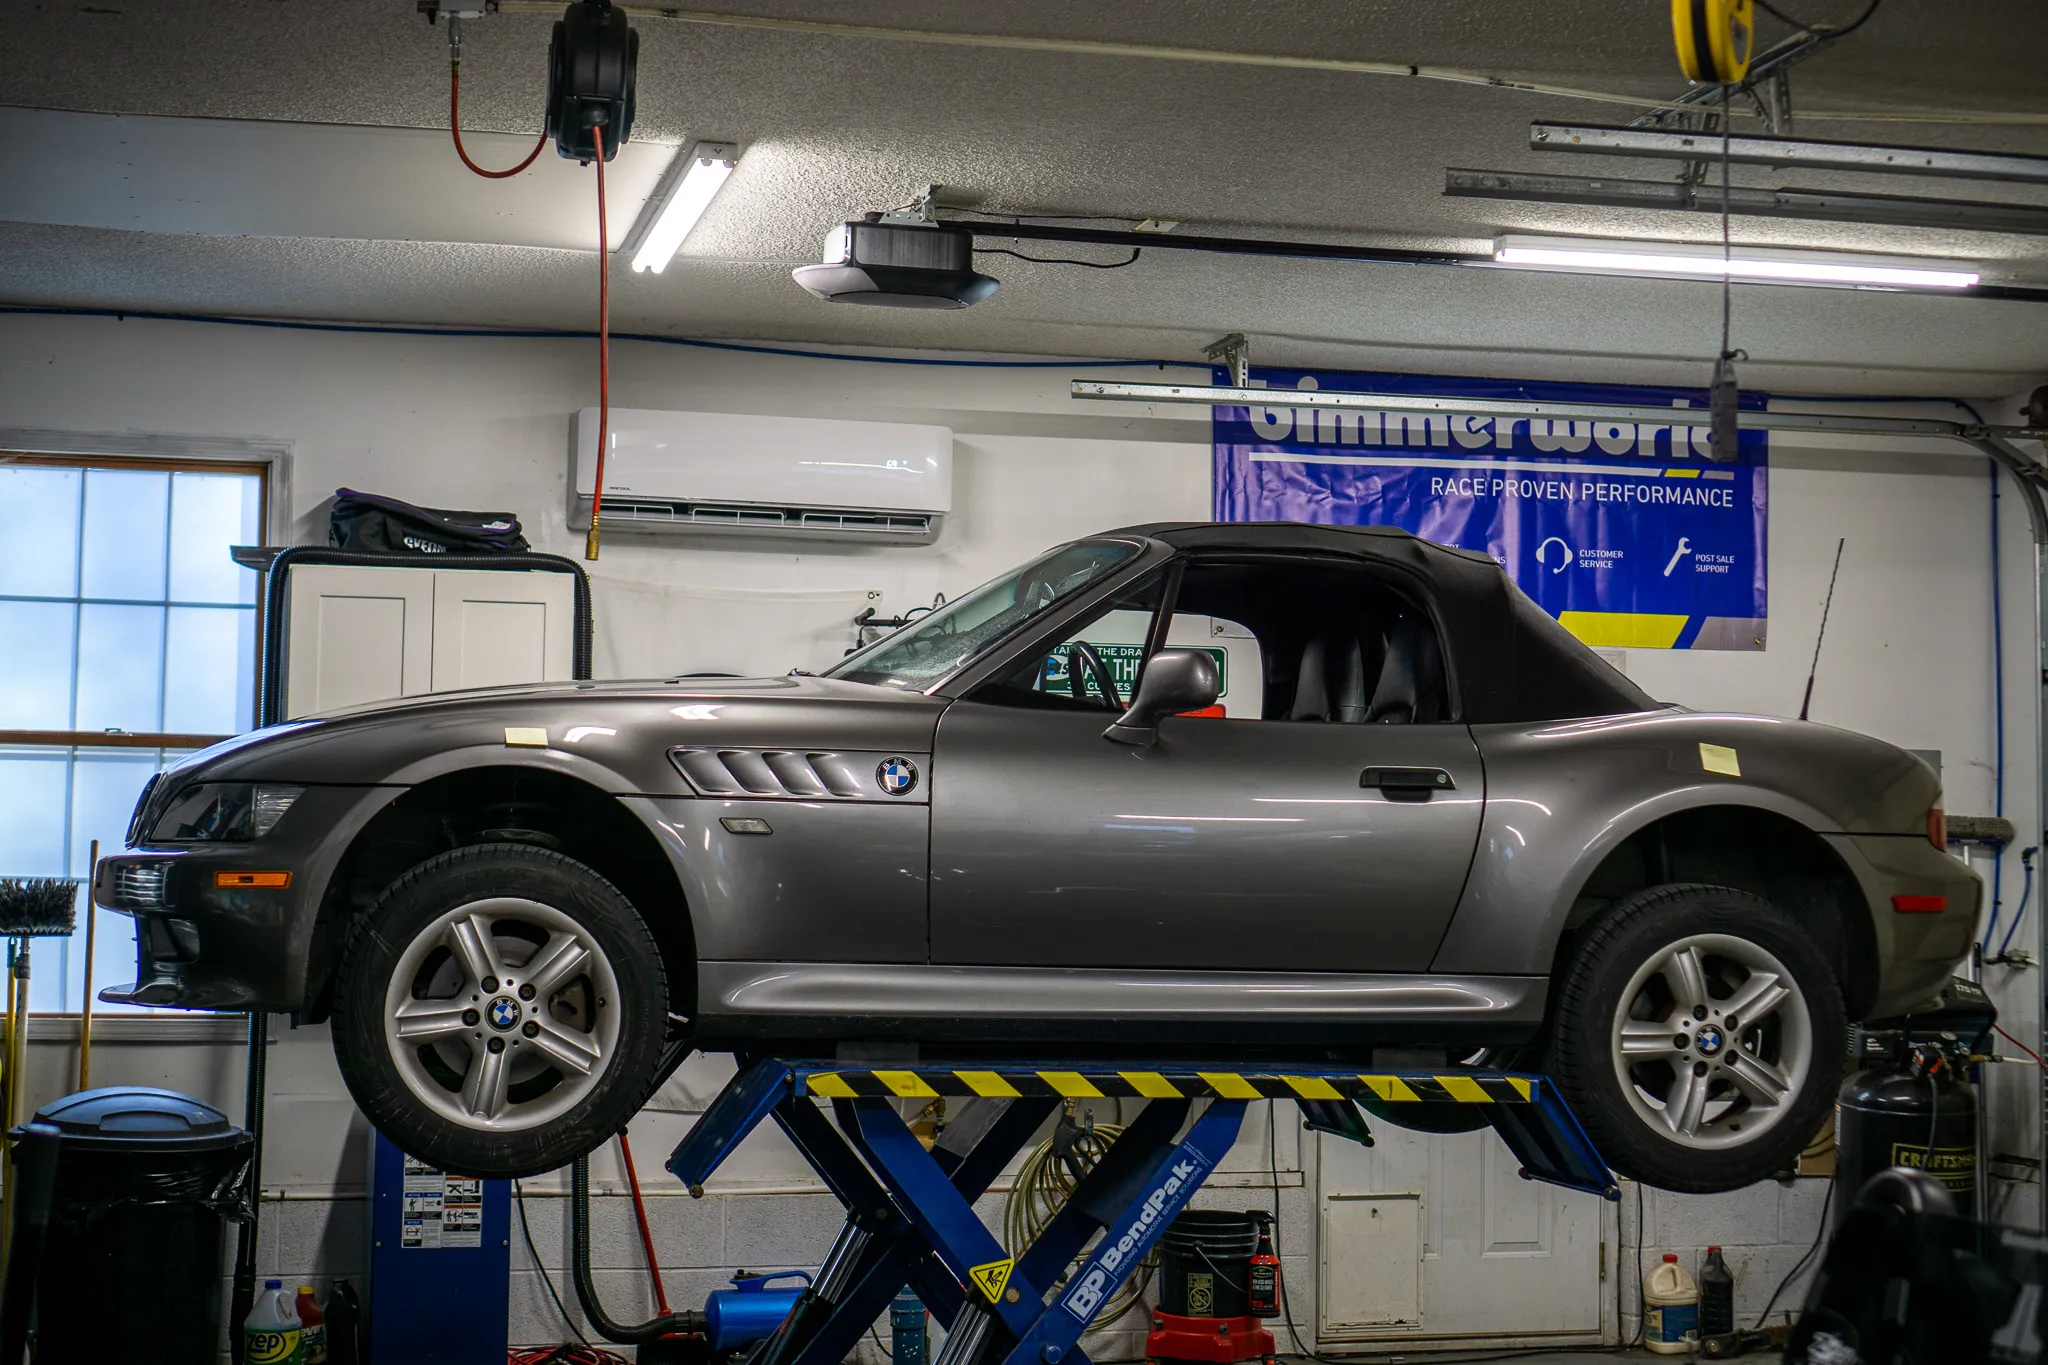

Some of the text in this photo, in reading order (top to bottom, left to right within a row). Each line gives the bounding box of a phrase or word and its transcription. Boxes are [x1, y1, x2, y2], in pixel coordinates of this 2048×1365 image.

[1431, 476, 1734, 508] RACE PROVEN PERFORMANCE
[1579, 549, 1624, 559] CUSTOMER
[1695, 553, 1735, 564] POST SALE
[1579, 559, 1613, 569] SERVICE
[1695, 563, 1729, 573] SUPPORT
[1097, 647, 1118, 656] THE
[1120, 648, 1143, 657] DRA
[1114, 1247, 1138, 1276] PROVIDING
[1137, 1216, 1163, 1248] AUTOMOTIVE
[1163, 1194, 1180, 1216] SERVICE
[1179, 1167, 1203, 1195] SOLUTIONS
[1067, 1159, 1195, 1319] BP BendPak
